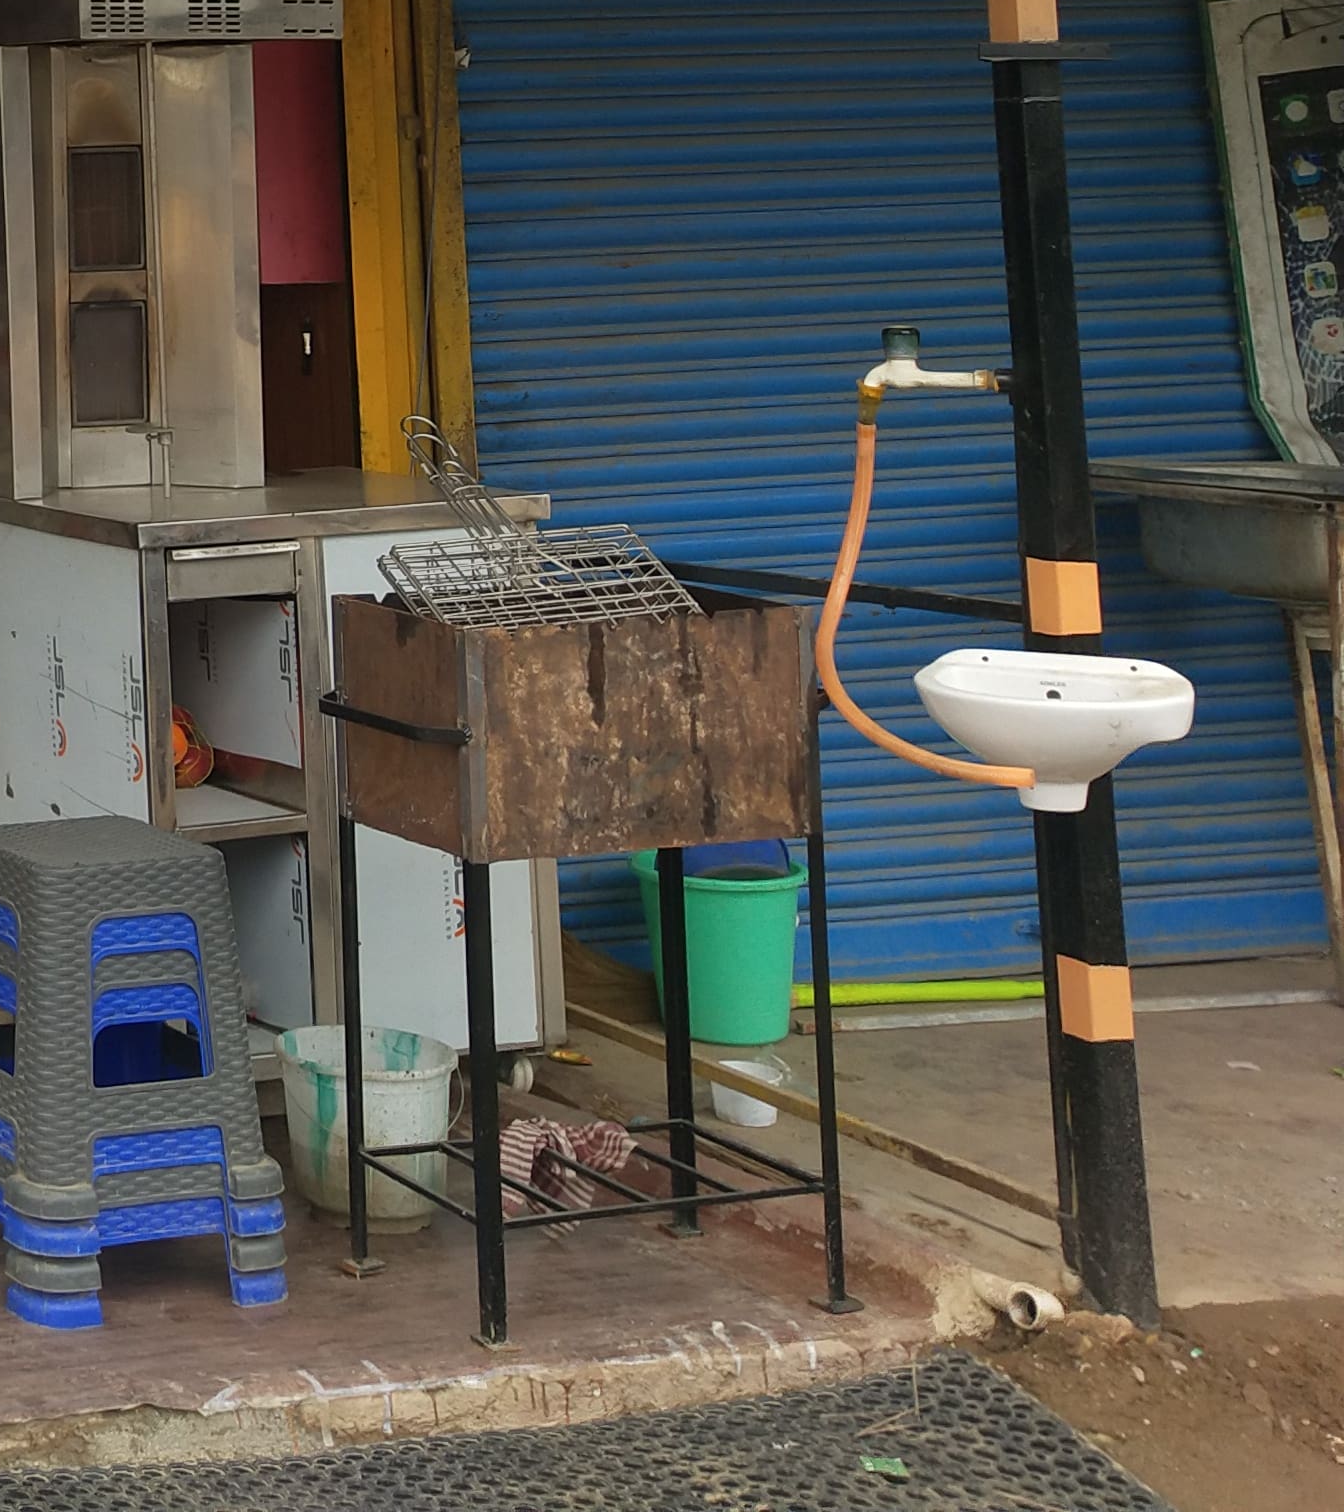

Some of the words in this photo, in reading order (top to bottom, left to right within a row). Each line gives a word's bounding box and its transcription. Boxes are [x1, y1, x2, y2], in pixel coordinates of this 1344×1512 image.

[52, 635, 66, 718] JSL
[129, 654, 143, 742] JSL
[279, 620, 293, 704] JSL
